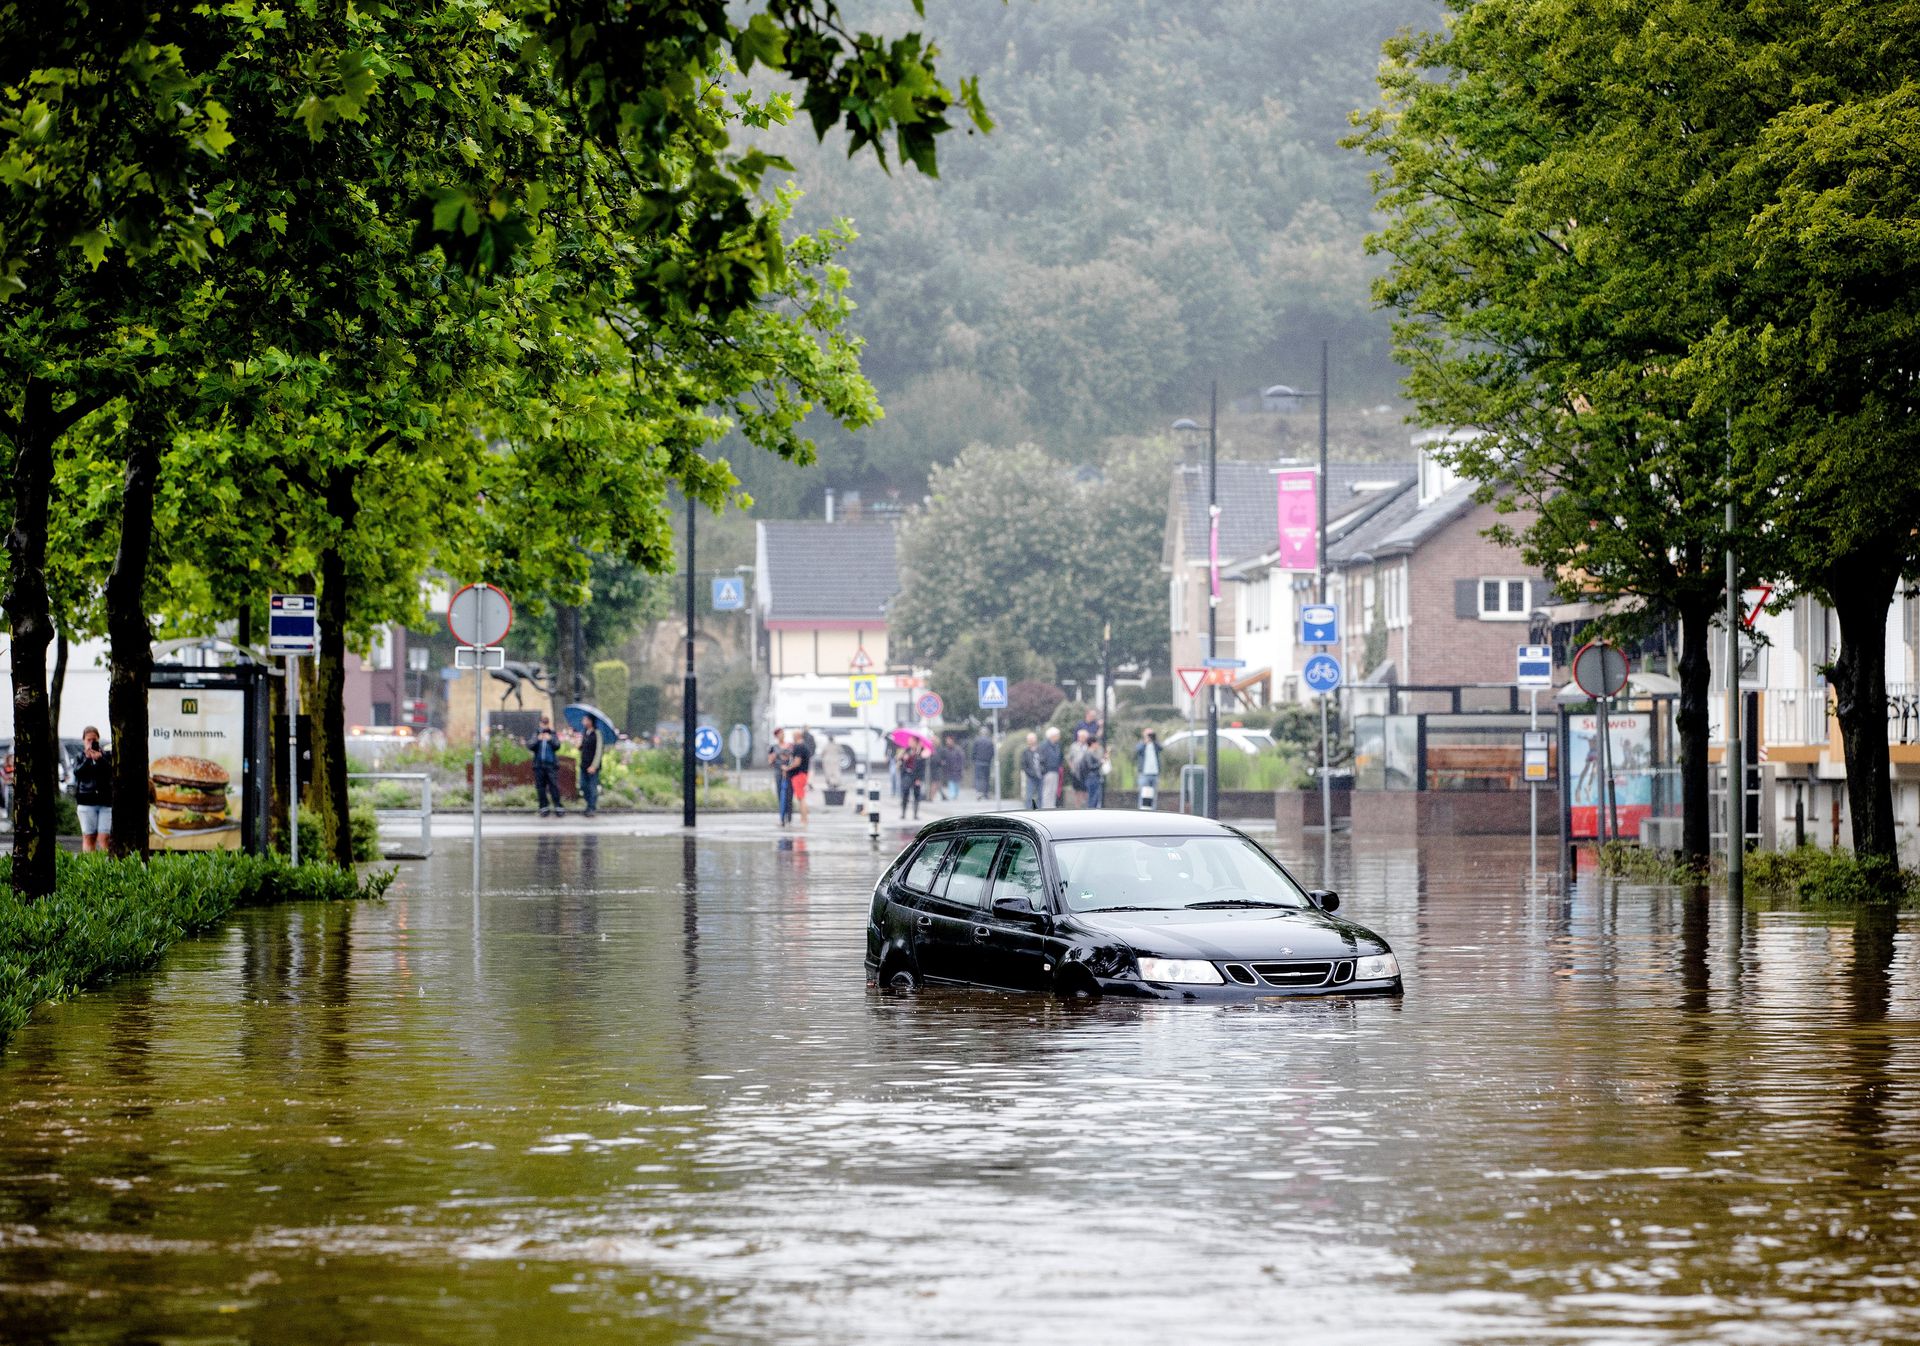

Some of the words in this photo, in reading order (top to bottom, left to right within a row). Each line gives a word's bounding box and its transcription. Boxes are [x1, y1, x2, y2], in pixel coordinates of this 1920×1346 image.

[1582, 717, 1636, 730] Suweb
[153, 727, 170, 739] Big
[173, 728, 226, 738] Mmmmm.
